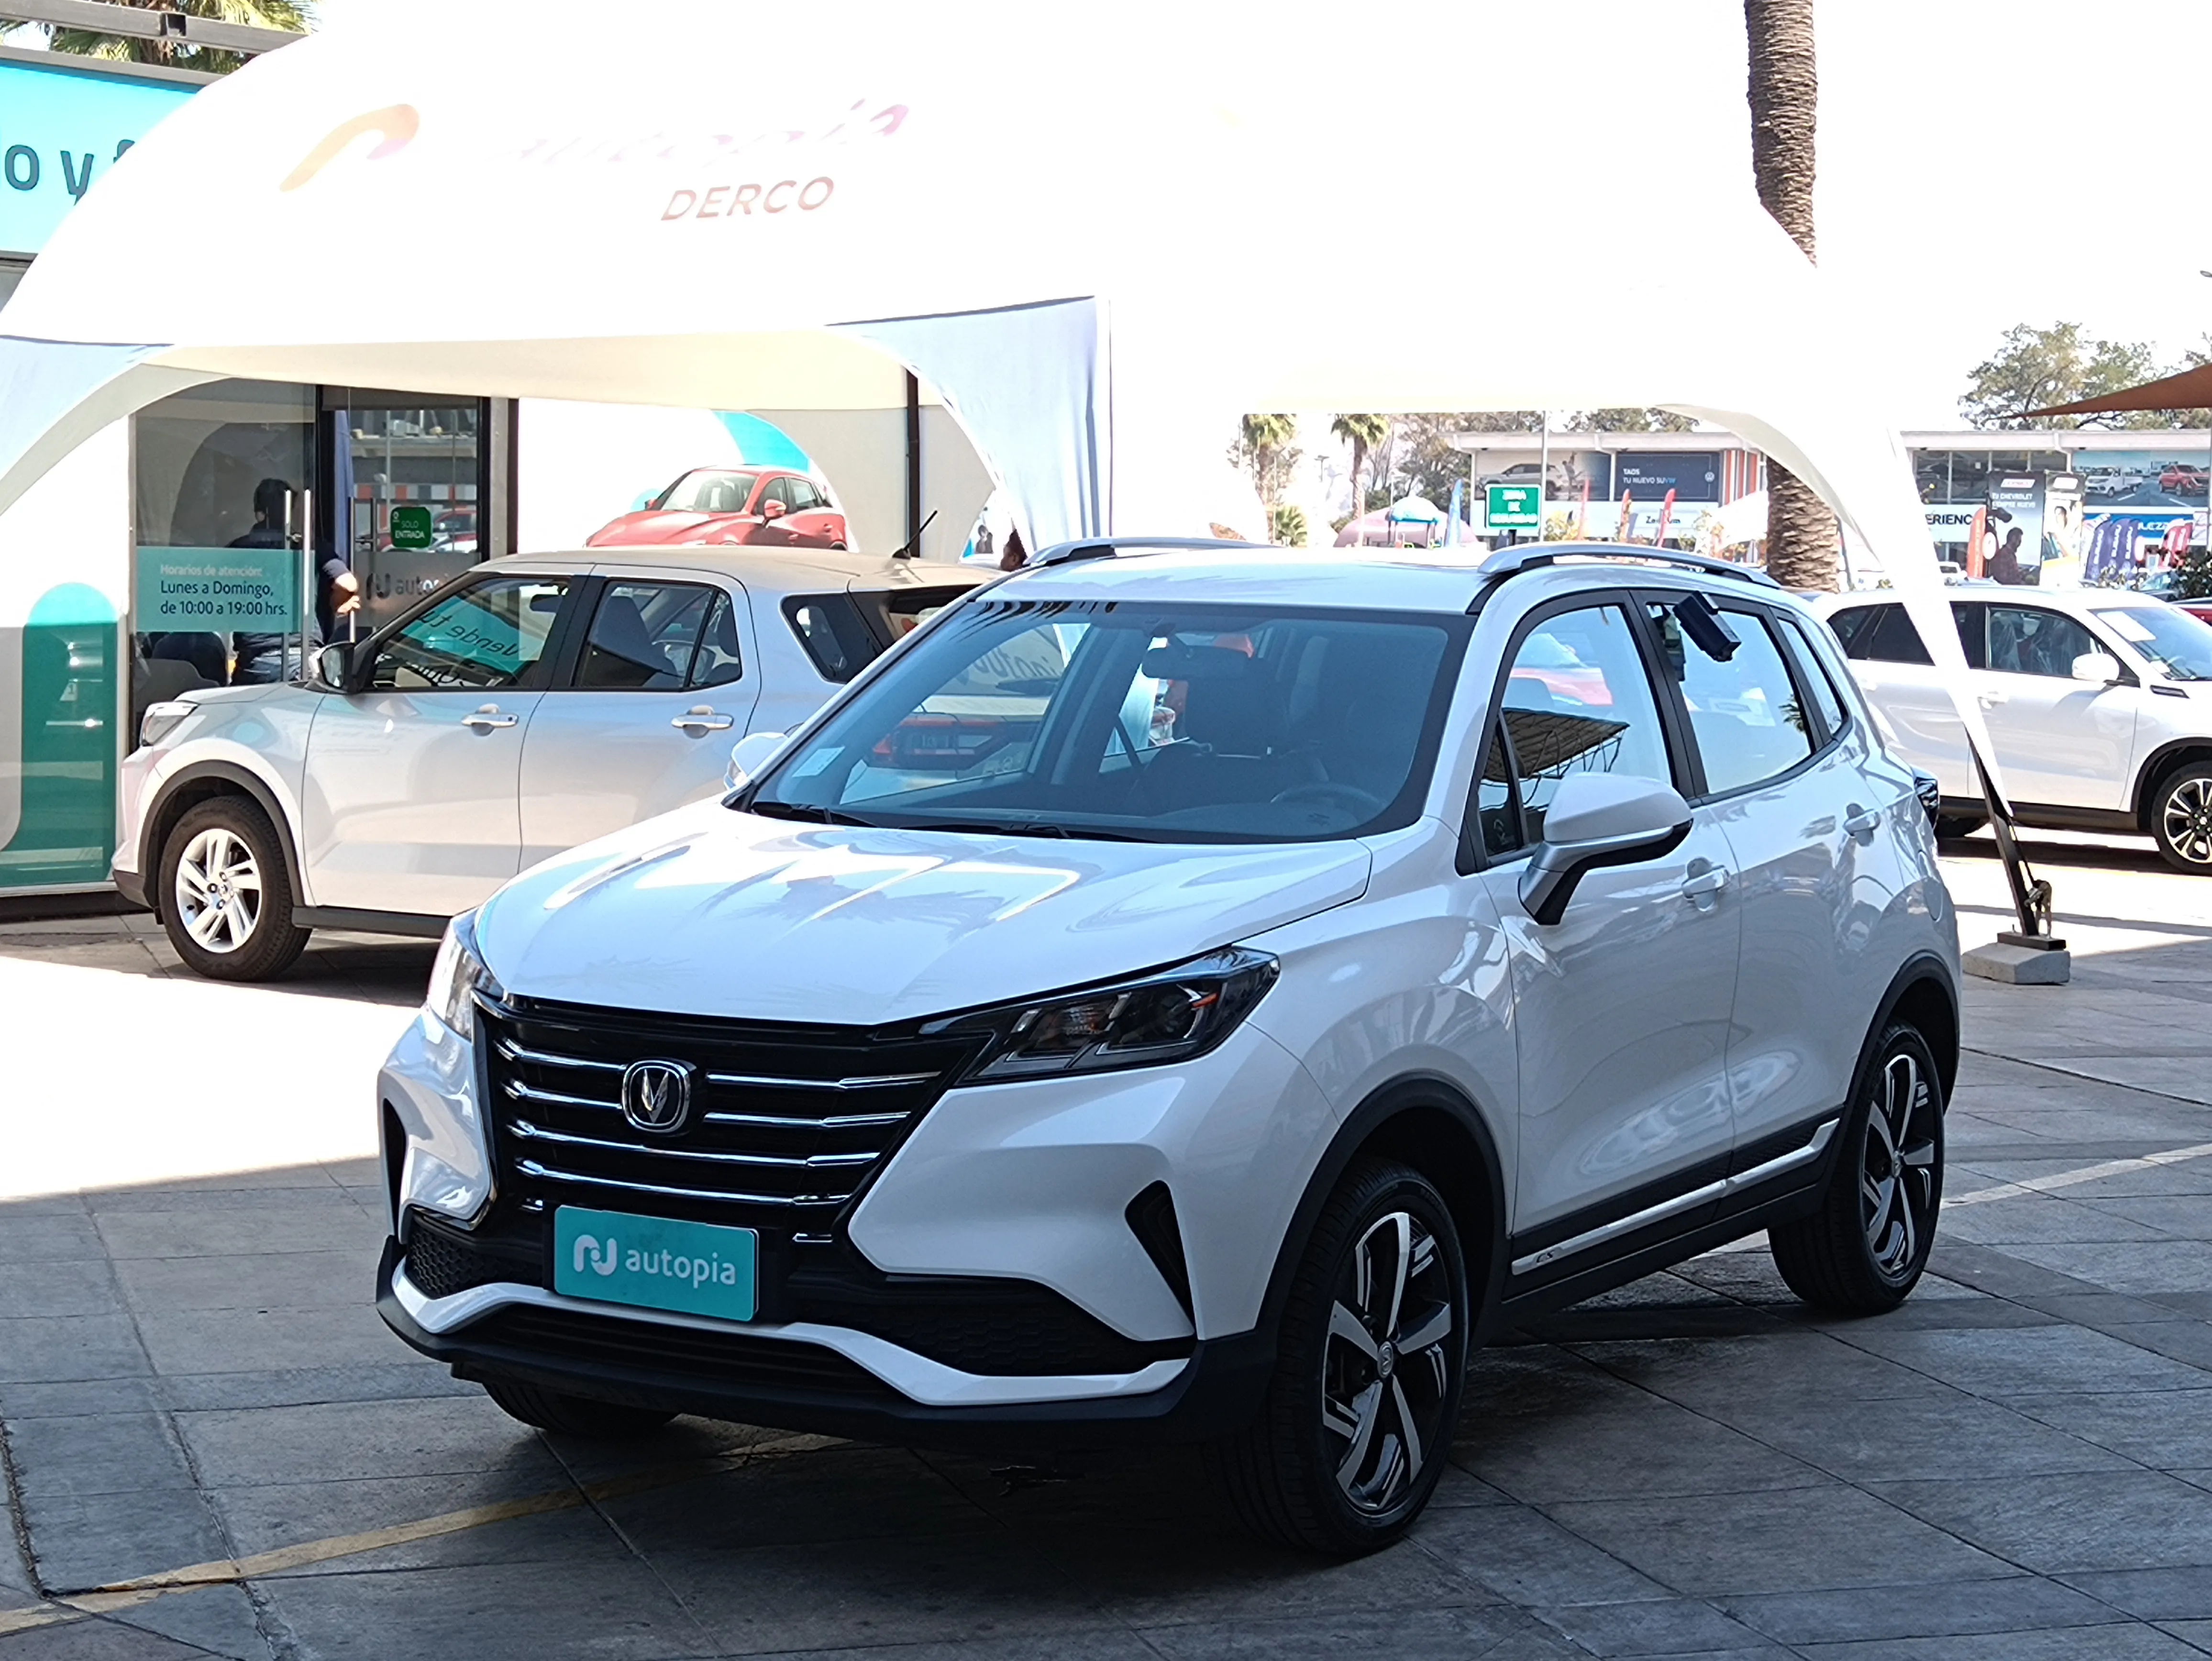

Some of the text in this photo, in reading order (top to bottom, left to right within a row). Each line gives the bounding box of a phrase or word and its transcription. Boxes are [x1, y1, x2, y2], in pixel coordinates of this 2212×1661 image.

[661, 176, 834, 221] DERCO
[401, 520, 420, 528] SOLO
[395, 530, 425, 539] ENTRADA
[160, 565, 201, 575] Horarios
[203, 565, 216, 576] de
[161, 580, 274, 599] Lunes a Domingo,
[160, 600, 288, 615] de 10:00 a 19:00 hrs.
[625, 1249, 736, 1289] autopia
